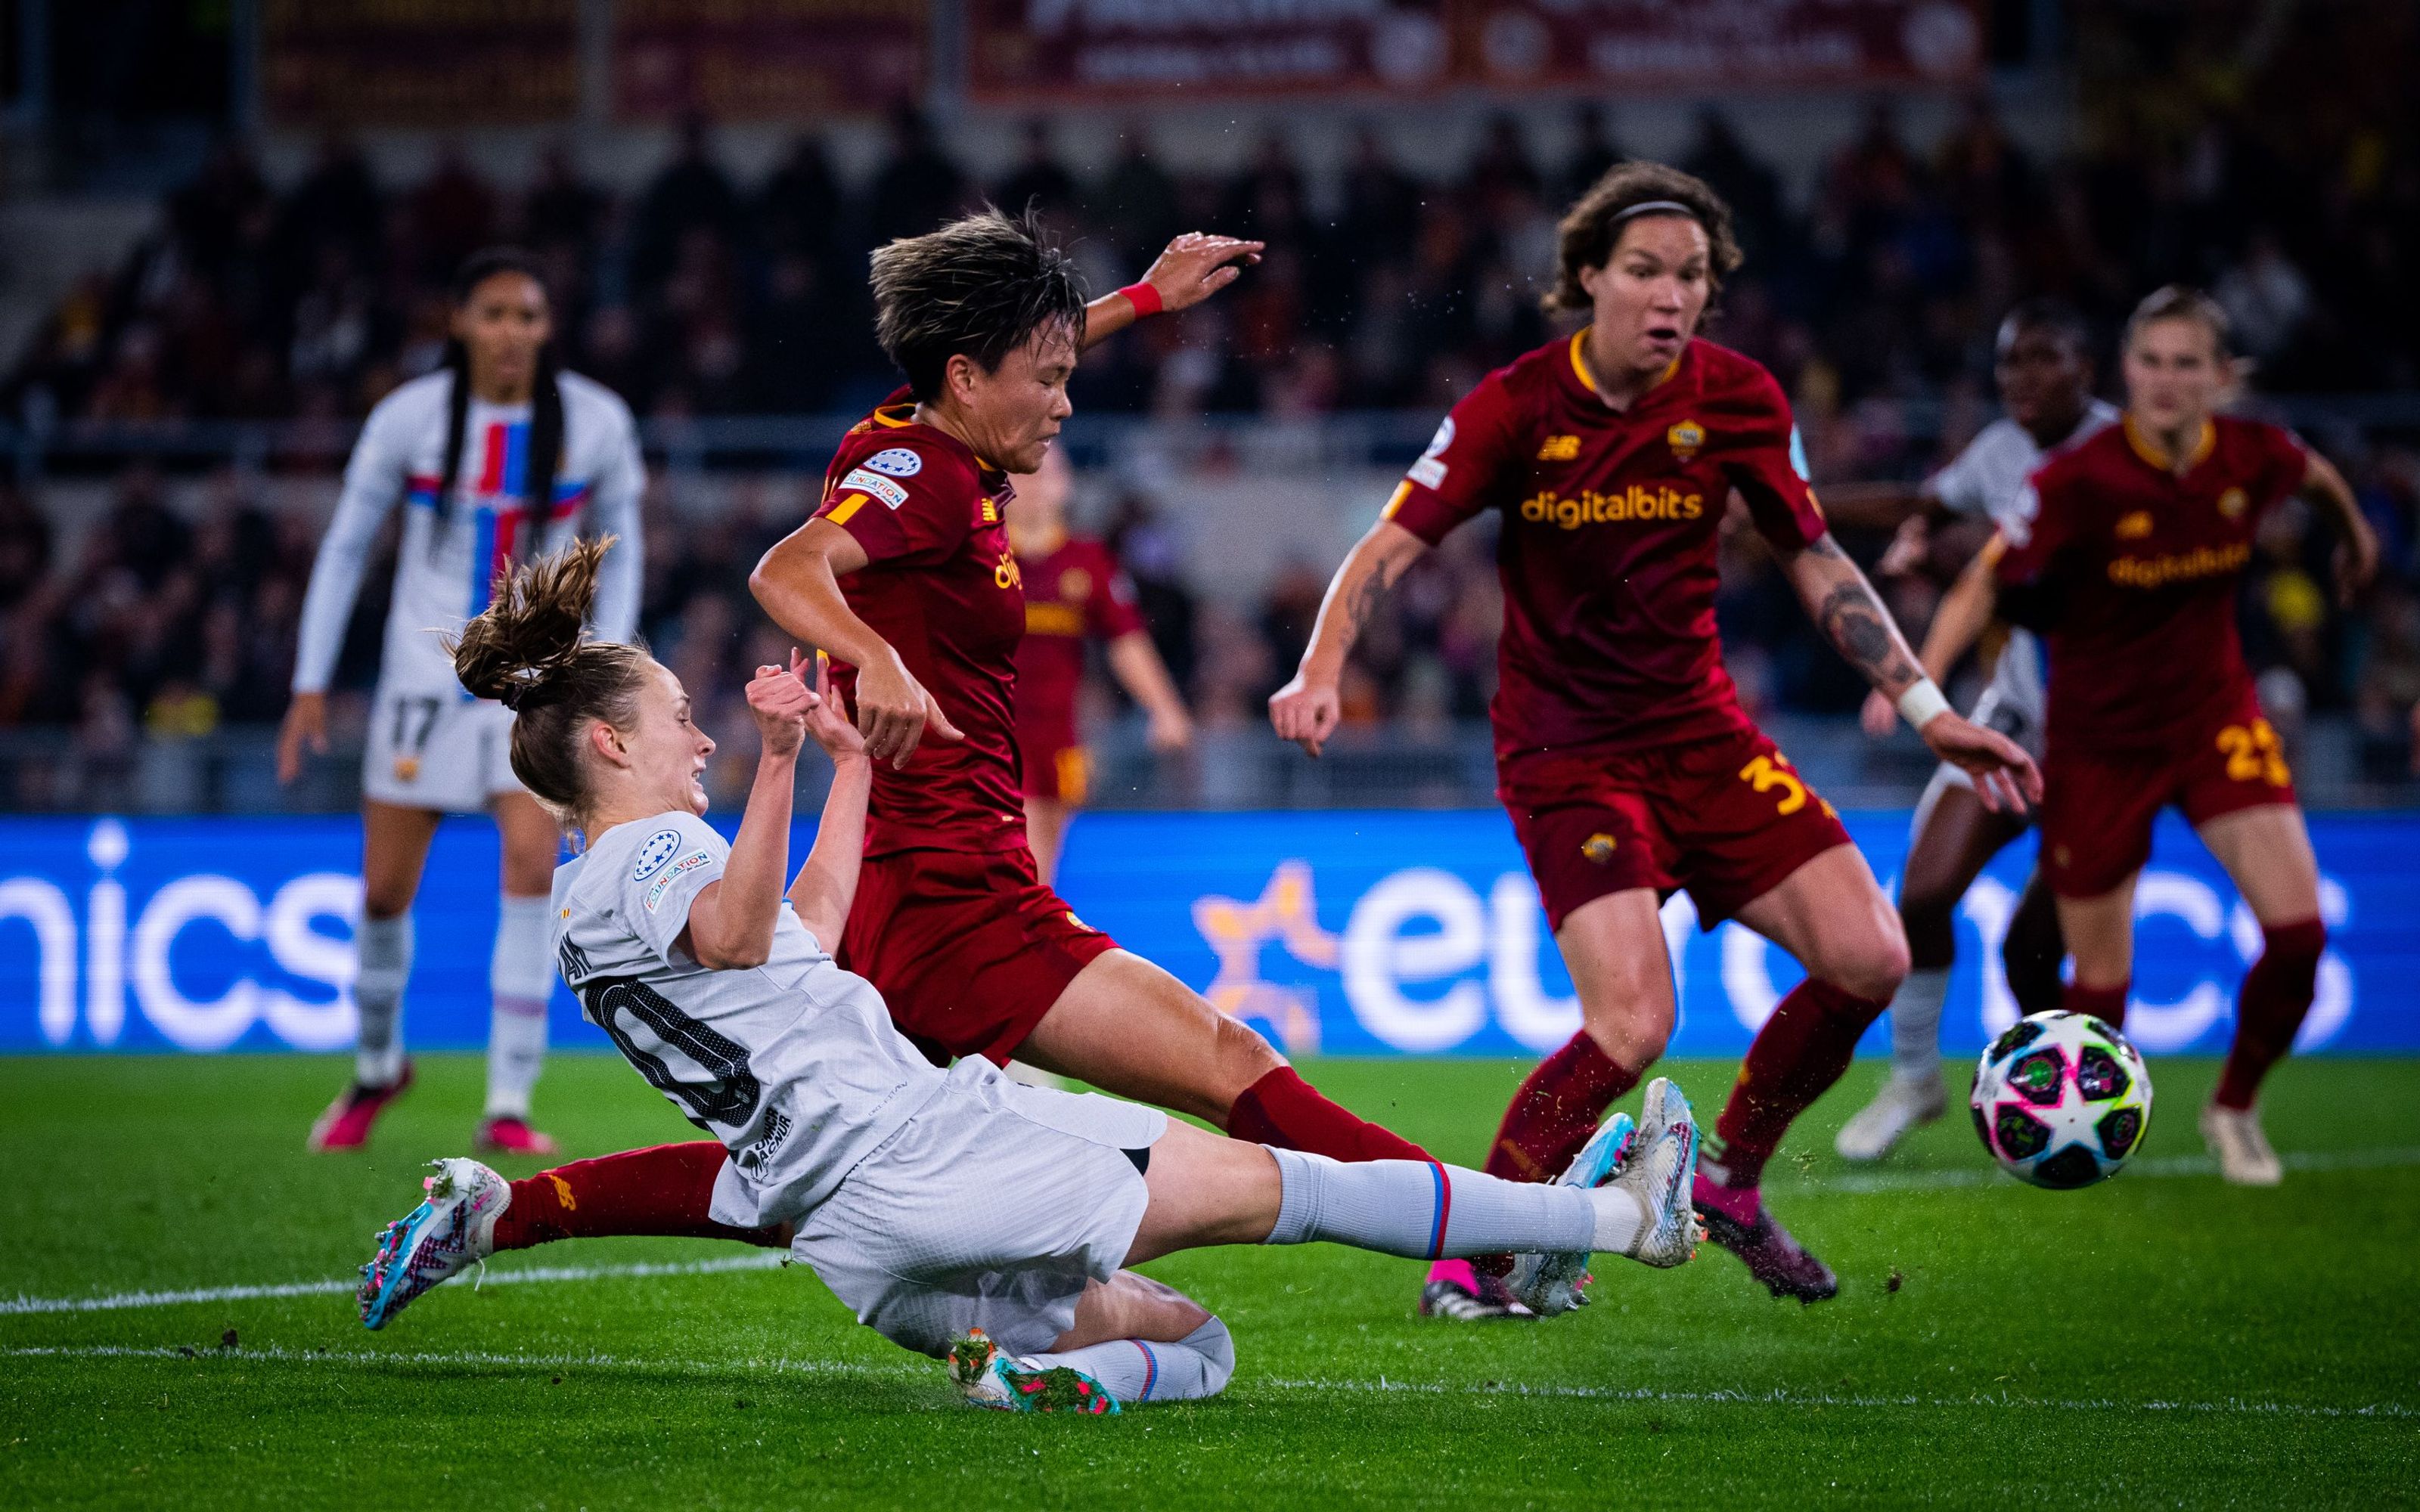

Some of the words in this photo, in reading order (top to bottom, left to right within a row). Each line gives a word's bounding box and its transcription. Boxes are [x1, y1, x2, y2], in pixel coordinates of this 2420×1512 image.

[845, 475, 903, 503] UNDATION
[1520, 484, 1705, 530] digitalbits
[392, 697, 441, 748] 17
[1739, 751, 1836, 819] 3
[646, 854, 708, 909] FOUNDATION
[557, 931, 593, 986] AM
[754, 1106, 779, 1151] UNHCR
[759, 1114, 792, 1168] ACNUR
